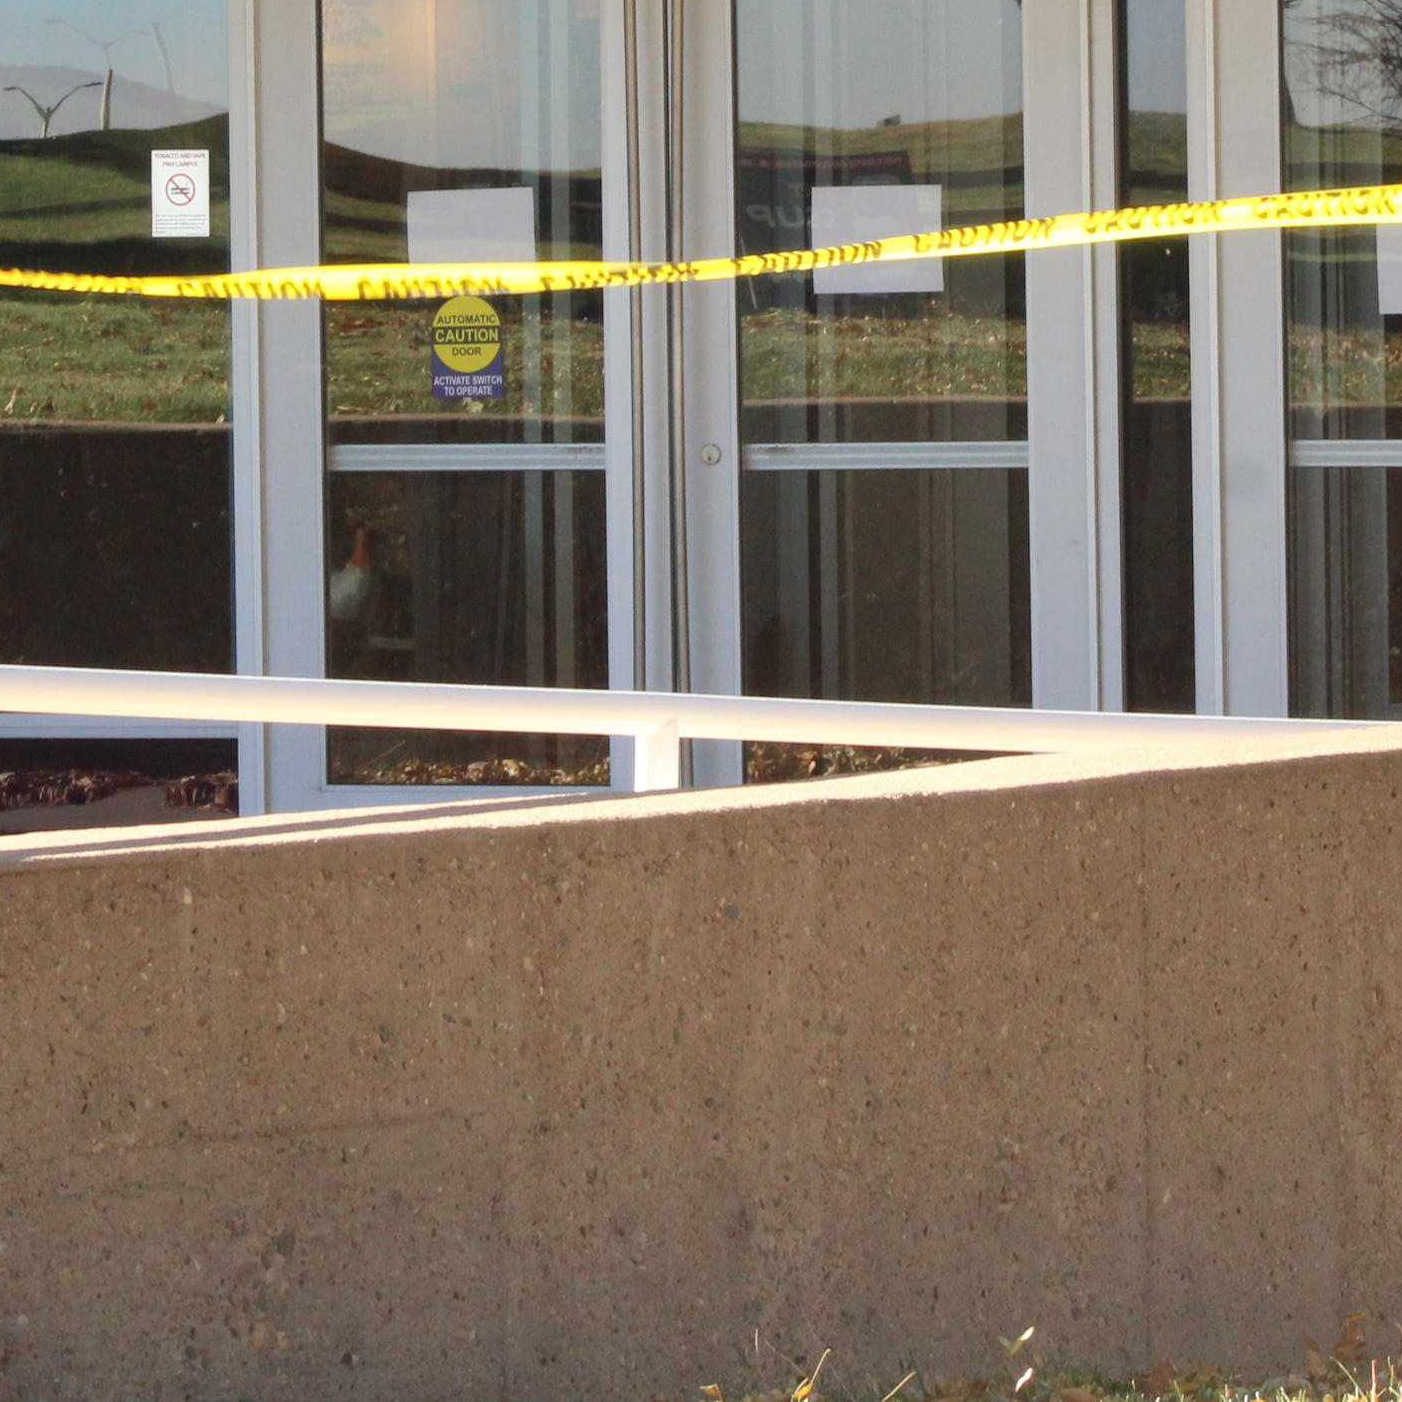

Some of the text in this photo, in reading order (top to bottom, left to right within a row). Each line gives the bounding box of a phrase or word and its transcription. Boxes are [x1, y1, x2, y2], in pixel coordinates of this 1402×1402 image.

[1253, 188, 1398, 220] CAUTION
[437, 314, 496, 324] AUTOMATIC
[435, 328, 498, 343] CAUTION
[452, 347, 481, 356] DOOR
[433, 375, 503, 386] ACTIVATE SWITCH
[444, 385, 493, 396] TO OPERATE
